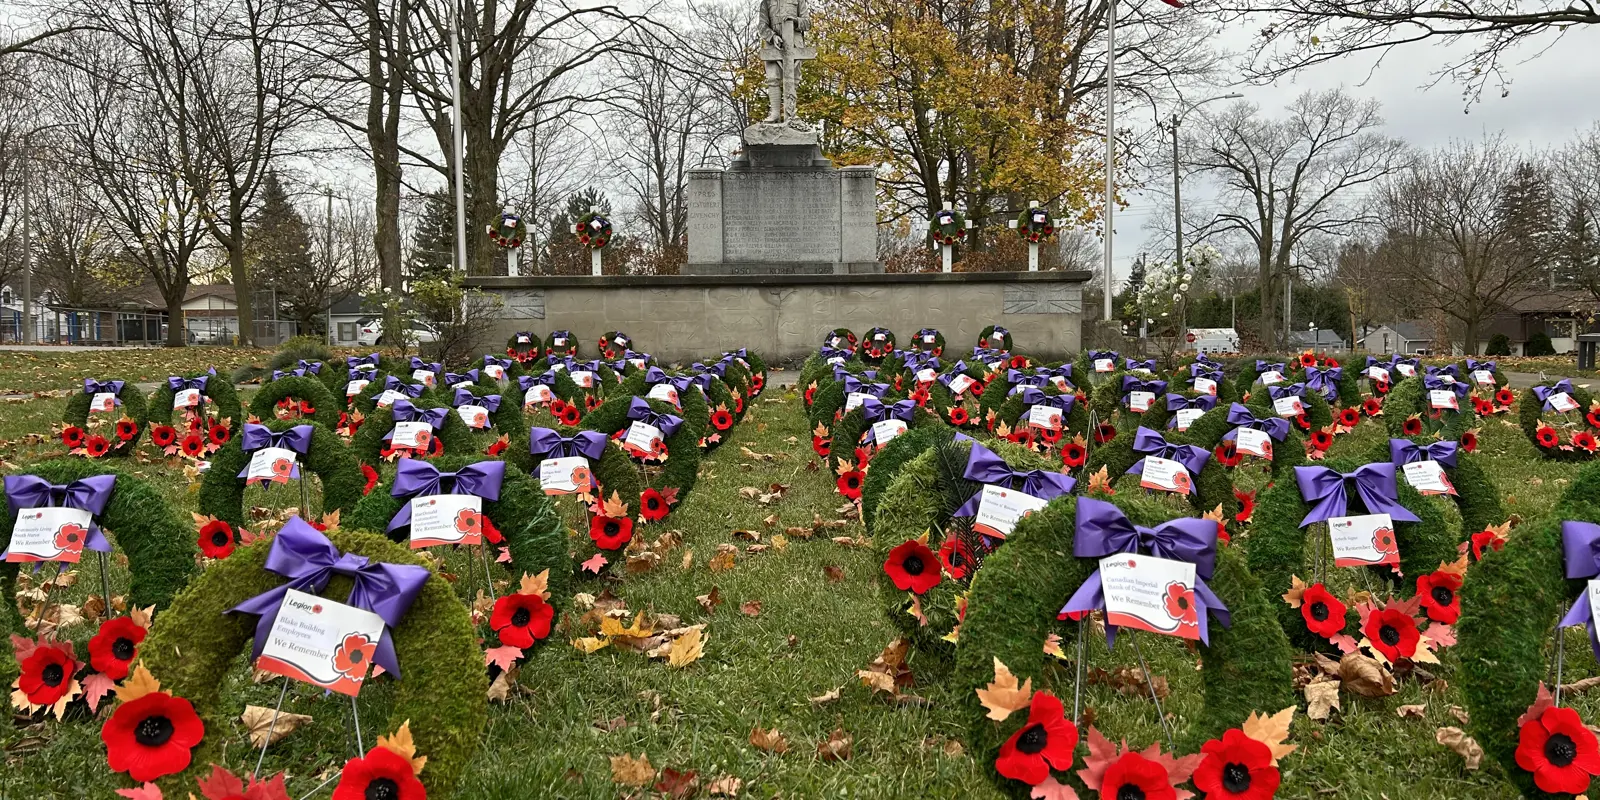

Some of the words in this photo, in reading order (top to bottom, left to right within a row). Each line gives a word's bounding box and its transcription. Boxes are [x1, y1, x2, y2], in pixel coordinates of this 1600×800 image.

[1135, 579, 1158, 588] Imperial
[1132, 586, 1159, 596] Commerce
[289, 599, 312, 612] Legion
[1126, 597, 1160, 610] Remember
[280, 616, 298, 627] Blake
[299, 622, 325, 635] Building
[277, 625, 312, 640] Employees
[274, 638, 287, 648] We
[288, 642, 329, 660] Remember
